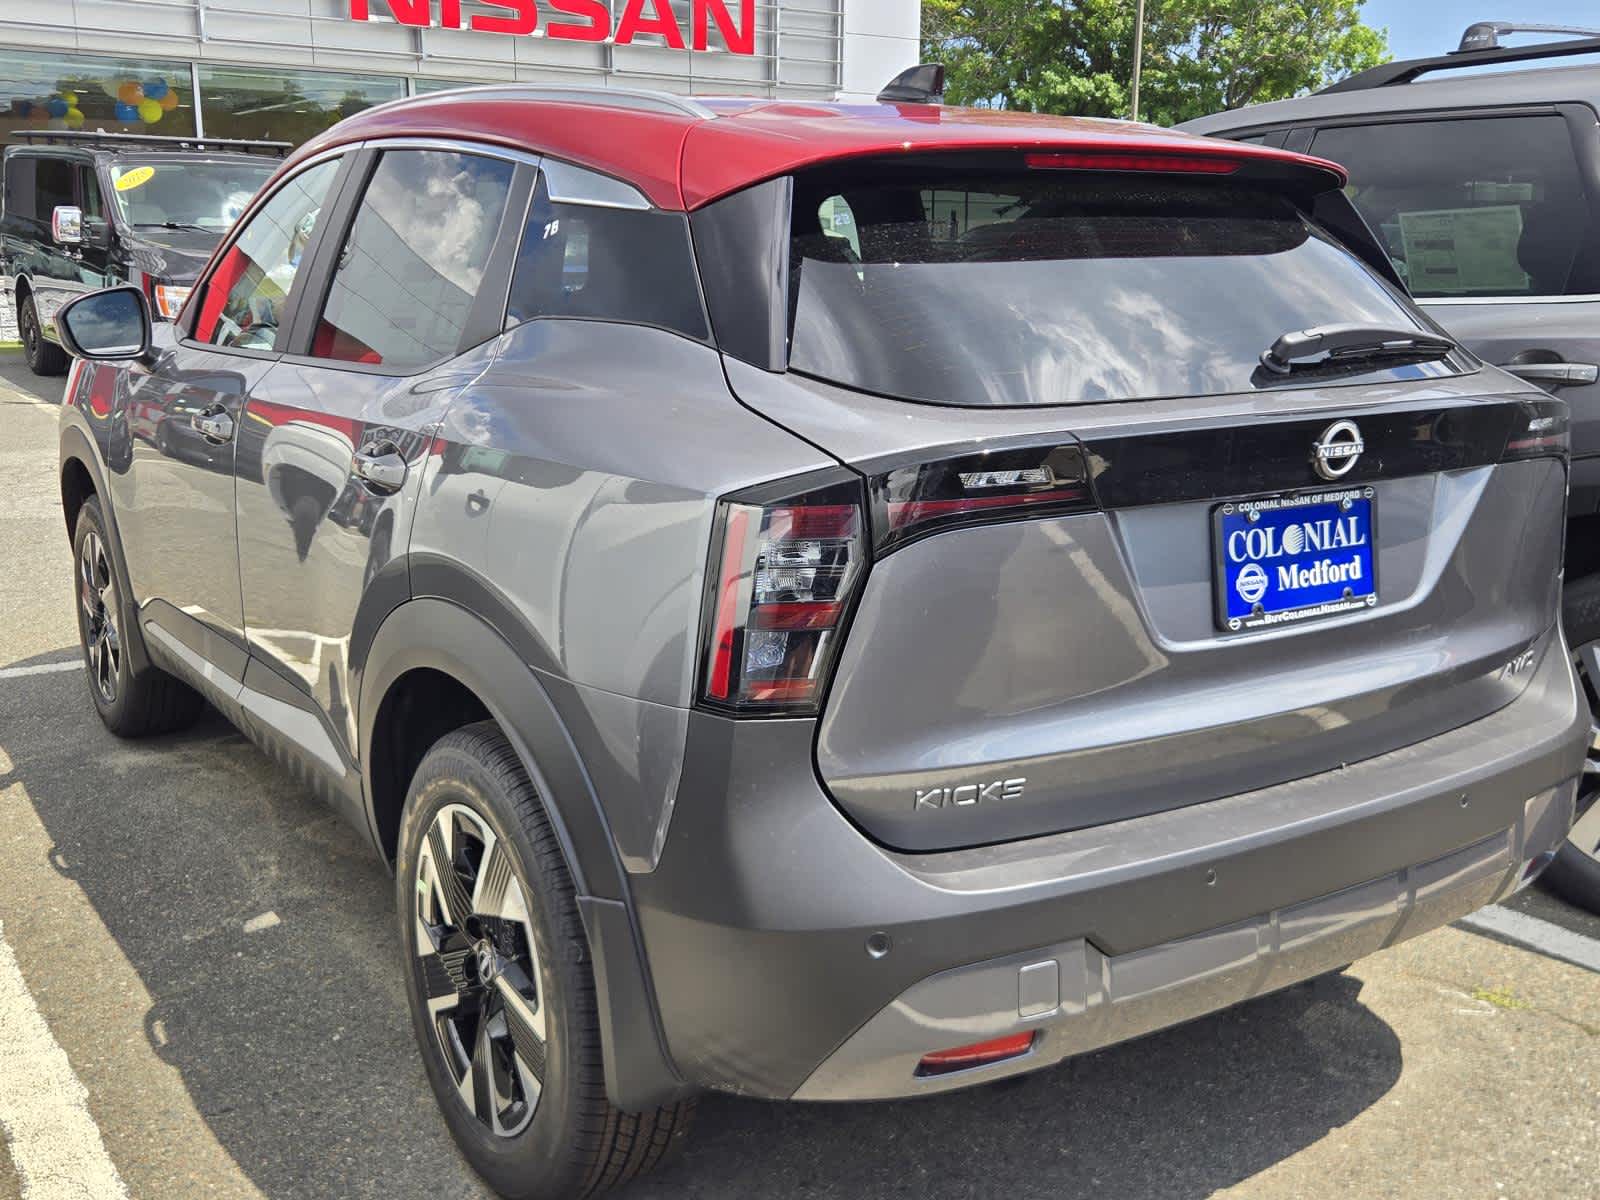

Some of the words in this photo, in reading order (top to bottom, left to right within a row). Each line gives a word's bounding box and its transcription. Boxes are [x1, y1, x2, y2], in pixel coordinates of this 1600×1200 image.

[1319, 444, 1364, 458] NISSAN
[1238, 498, 1280, 513] COLONIAL
[1281, 496, 1311, 508] NISSAN
[1312, 494, 1323, 504] OF
[1324, 490, 1361, 503] MEDFORD
[1228, 516, 1366, 563] COLONIAL
[1277, 555, 1363, 592] Medford
[914, 778, 1027, 811] KICKS
